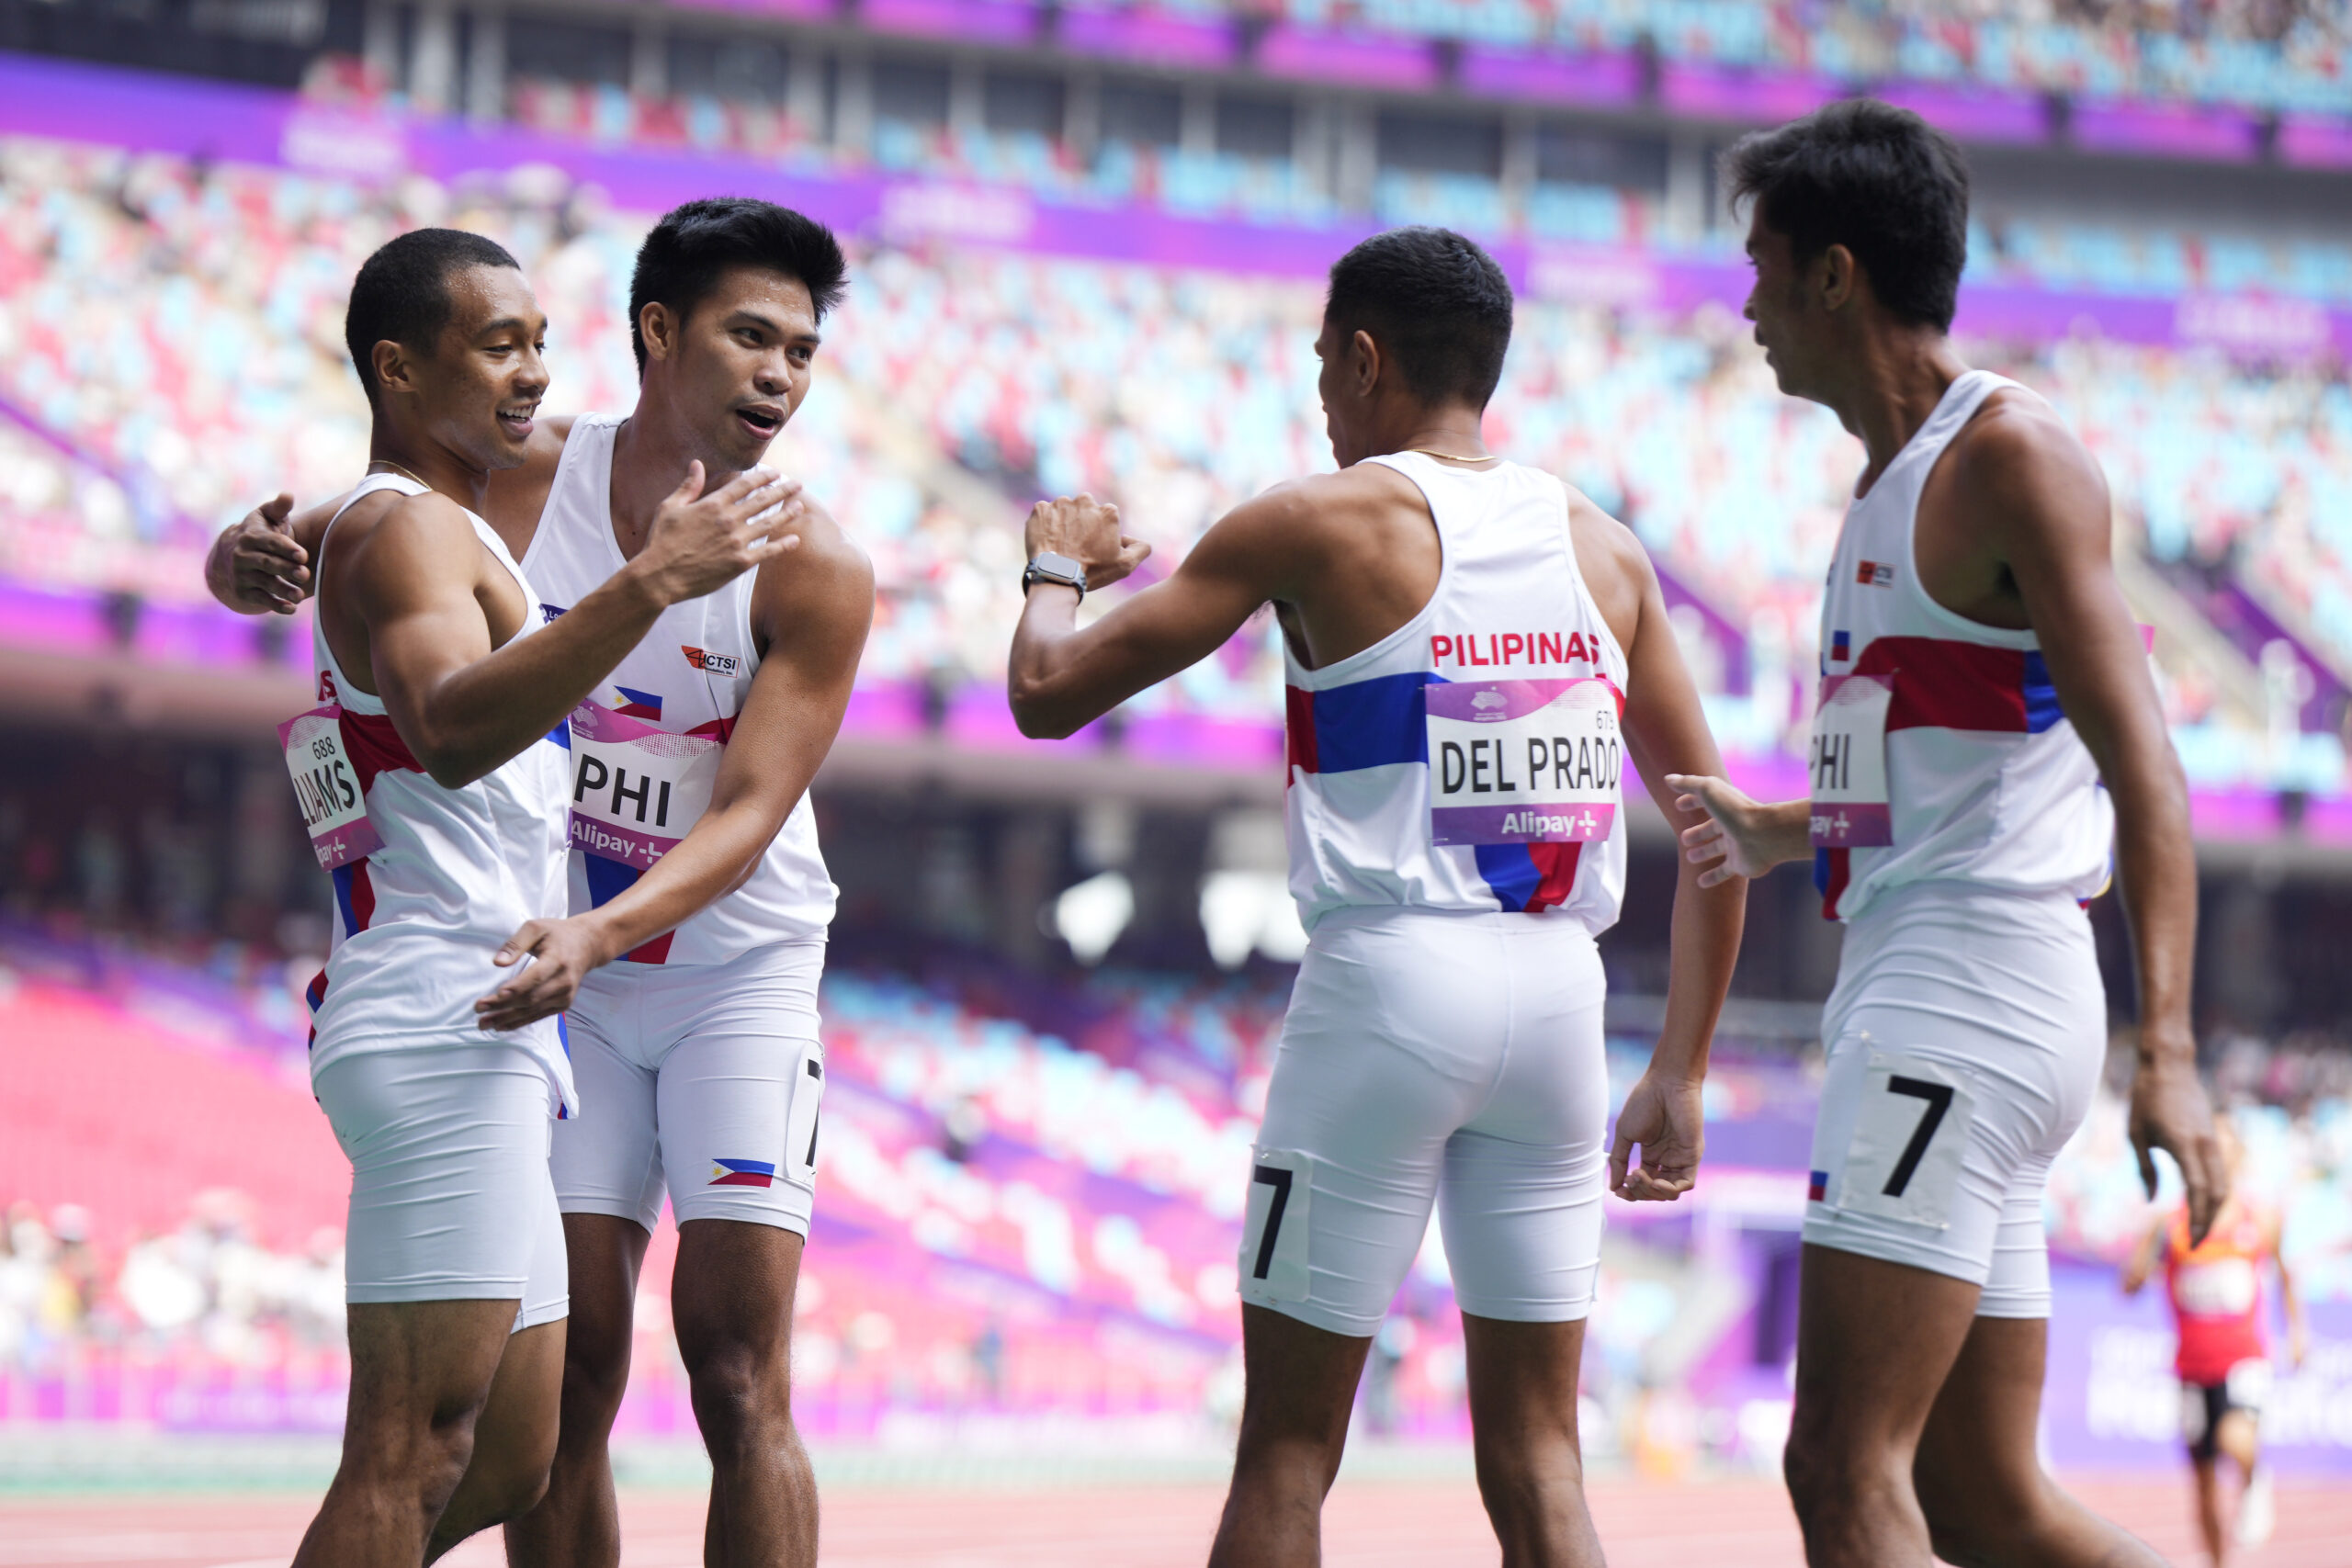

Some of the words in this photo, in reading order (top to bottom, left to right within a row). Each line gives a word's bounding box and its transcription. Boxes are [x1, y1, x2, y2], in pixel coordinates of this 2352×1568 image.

[312, 737, 335, 761] 688
[1441, 739, 1515, 794] DEL
[1528, 737, 1619, 791] PRADO
[573, 753, 671, 828] PHI
[1882, 1074, 1955, 1198] 7
[1253, 1165, 1293, 1280] 7
